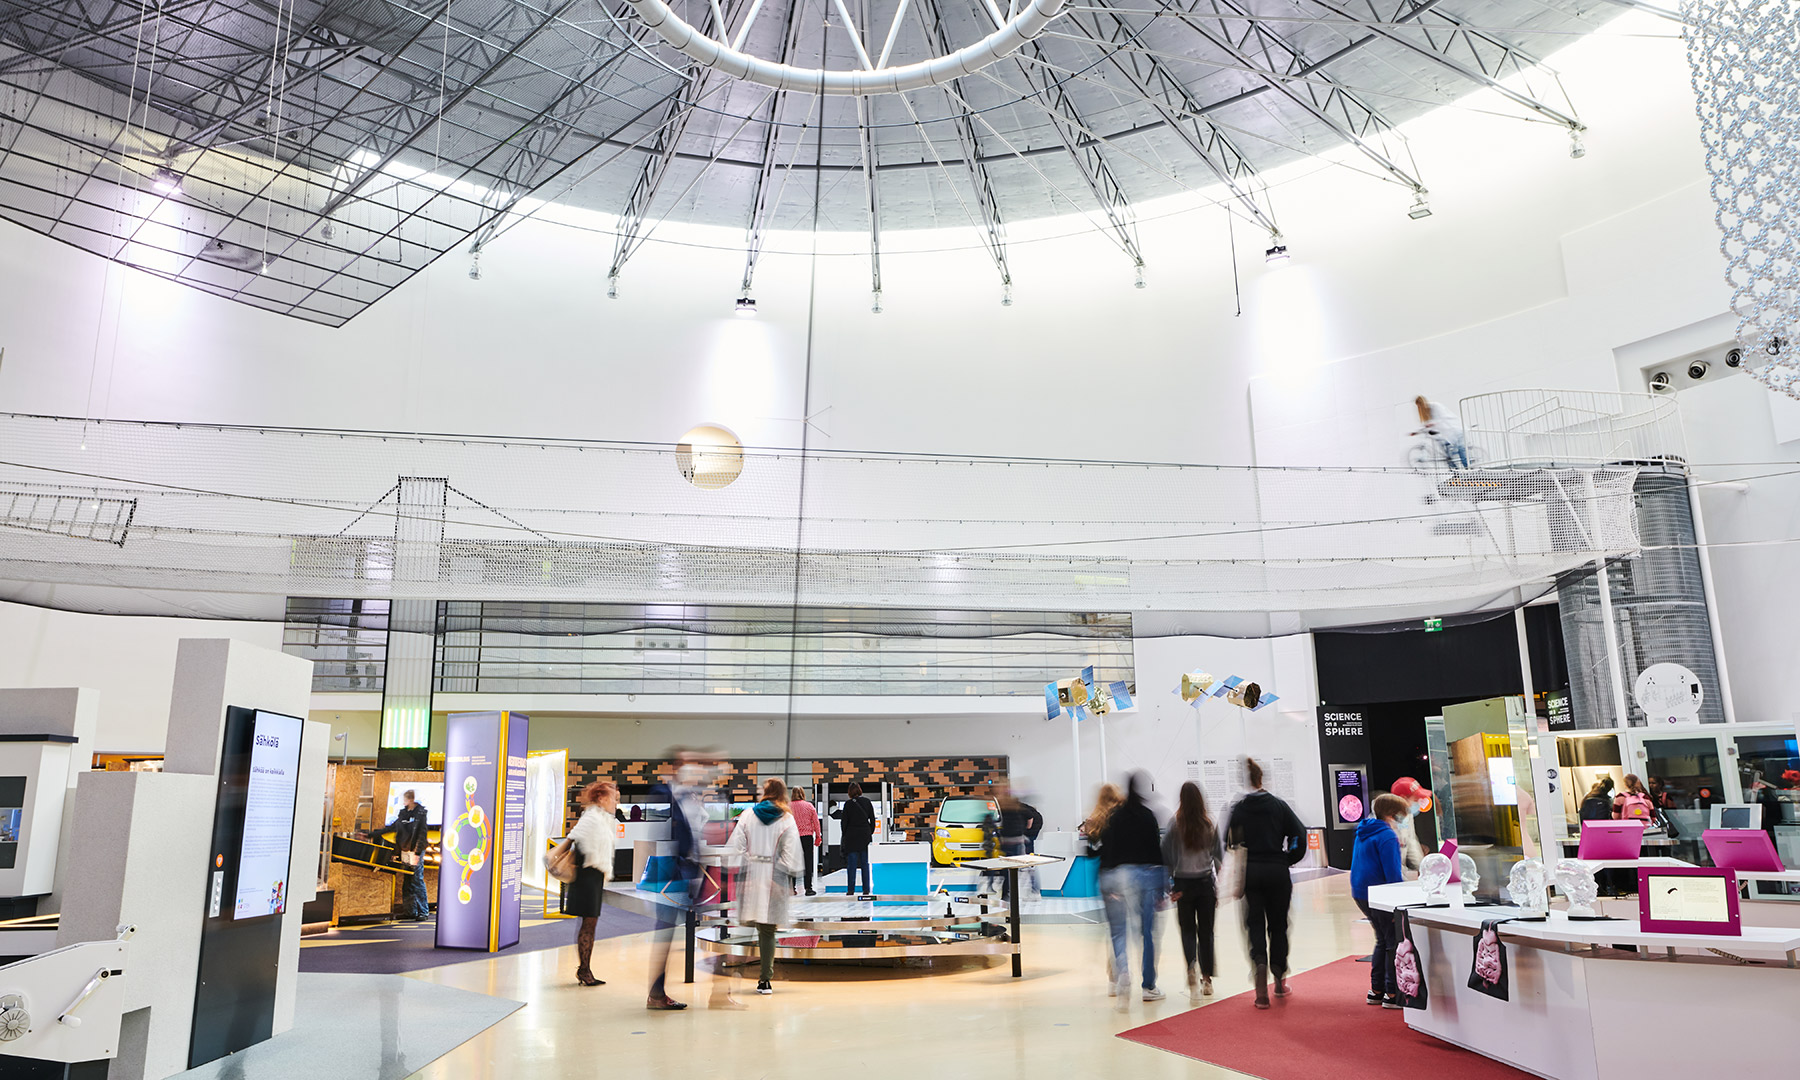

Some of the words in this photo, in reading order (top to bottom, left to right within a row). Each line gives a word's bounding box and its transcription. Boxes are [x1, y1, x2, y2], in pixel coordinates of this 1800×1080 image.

[1548, 697, 1568, 709] SCIENCE
[1324, 712, 1362, 720] SCIENCE
[1550, 714, 1570, 724] SPHERE
[1325, 728, 1363, 736] SPHERE
